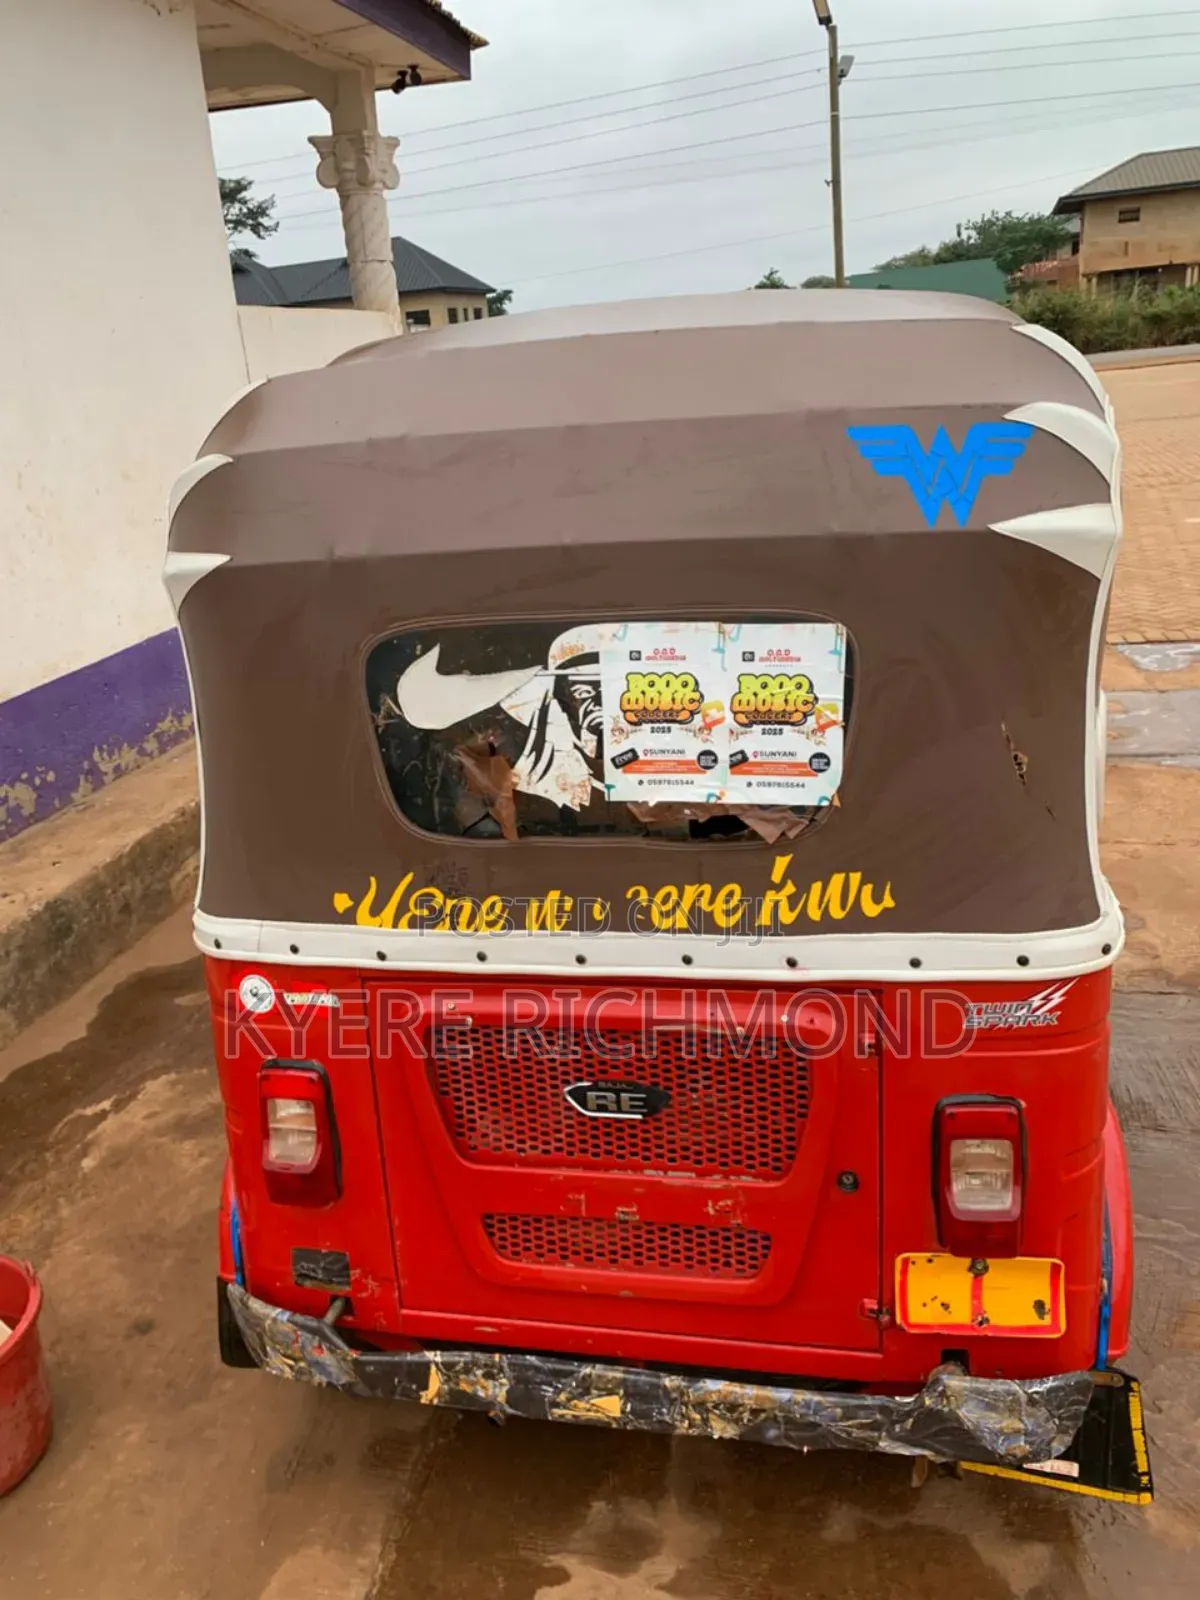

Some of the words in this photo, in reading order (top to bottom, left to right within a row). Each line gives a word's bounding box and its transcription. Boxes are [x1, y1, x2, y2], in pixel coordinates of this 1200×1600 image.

[759, 750, 797, 758] SUNYANI
[965, 1011, 1062, 1029] SPARK
[586, 1091, 648, 1112] RE
